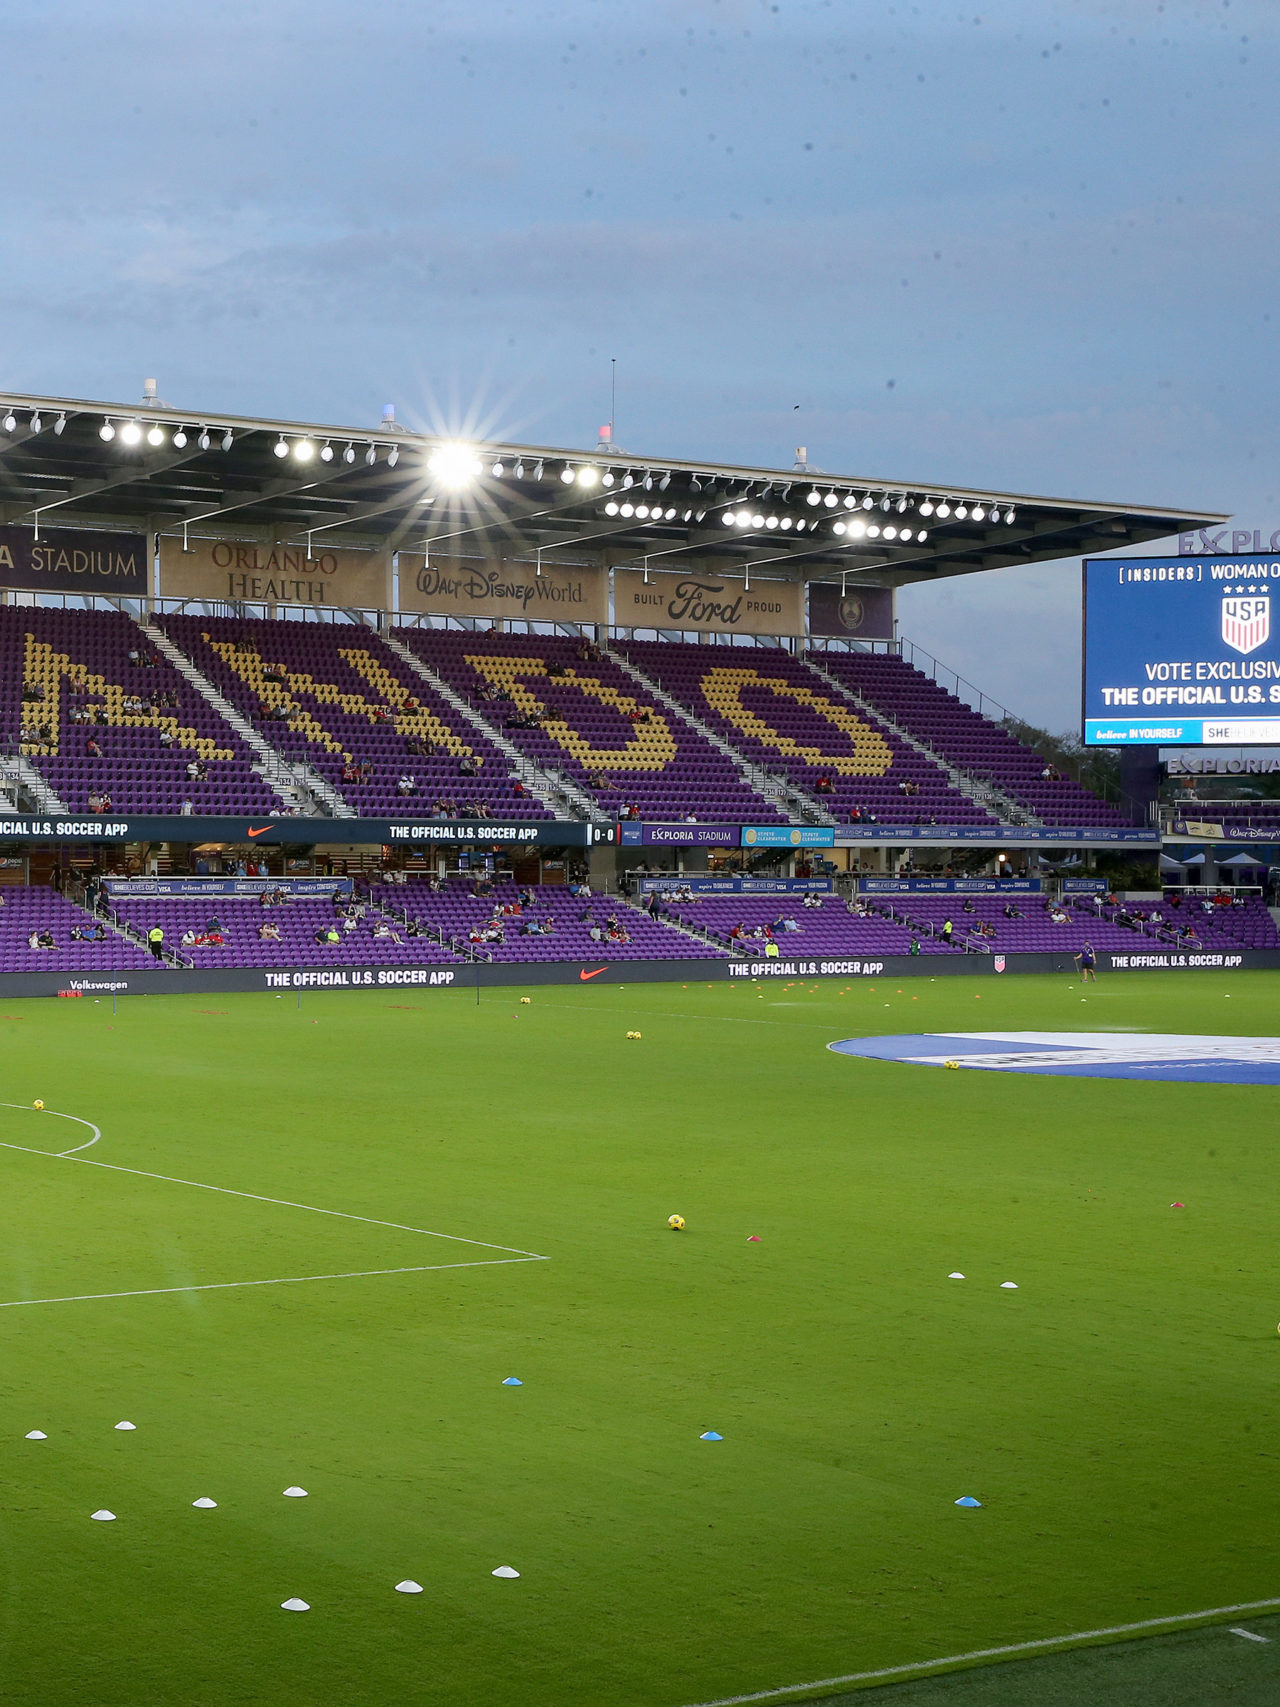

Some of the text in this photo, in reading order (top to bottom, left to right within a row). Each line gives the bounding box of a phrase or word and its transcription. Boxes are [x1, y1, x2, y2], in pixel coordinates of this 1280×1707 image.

[31, 547, 137, 577] STADIUM
[211, 542, 338, 575] ORLANDO
[1210, 563, 1268, 580] WOMAN
[227, 572, 325, 602] HEALTH
[534, 580, 582, 603] World
[634, 581, 782, 624] BUILT Ford PROUD
[1226, 601, 1265, 621] USA
[1145, 661, 1280, 681] VOTE EXCLUSIV
[1101, 688, 1138, 705] THE
[1142, 686, 1227, 705] OFFICIAL
[1230, 686, 1266, 703] U.S.
[1096, 728, 1183, 740] believe IN YOURSELF
[32, 822, 54, 835] U.S.
[56, 822, 103, 835] SOCCER
[104, 823, 128, 836] APP
[390, 826, 538, 840] THE OFFICIAL U.S. SOCCER APP
[651, 828, 694, 840] EXPLORIA
[698, 831, 731, 841] STADIUM
[728, 962, 883, 976] THE OFFICIAL U.S. SOCCER APP
[1111, 955, 1242, 968] THE OFFICIAL U.S. SOCCER APP
[70, 980, 128, 991] Volkswagen
[265, 970, 454, 986] THE OFFICIAL U.S. SOCCER APP
